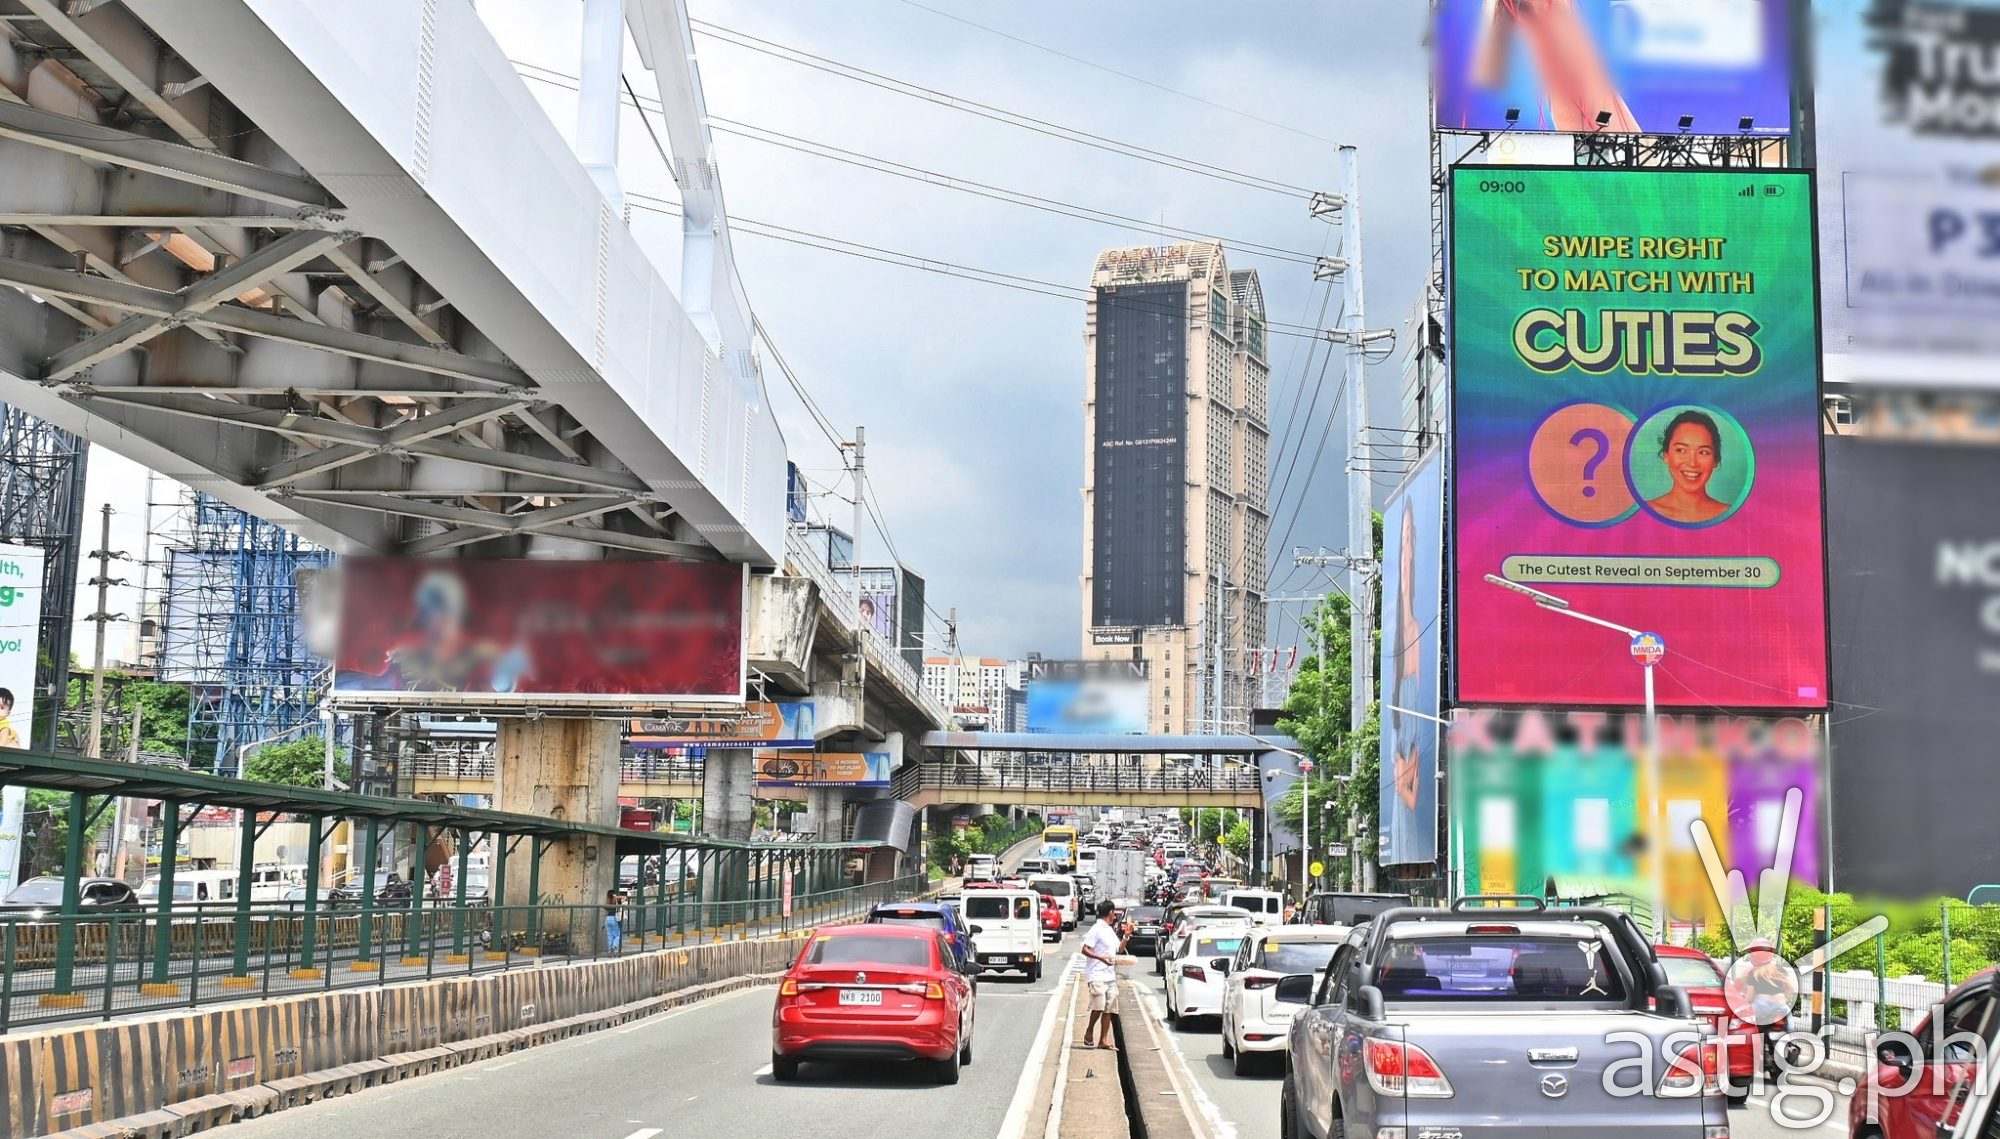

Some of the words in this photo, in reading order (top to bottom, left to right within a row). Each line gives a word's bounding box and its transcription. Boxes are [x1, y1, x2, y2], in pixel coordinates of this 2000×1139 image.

[1480, 180, 1526, 193] 09:00
[1543, 235, 1633, 259] SWIPE
[1638, 237, 1726, 260] RIGHT
[1517, 268, 1558, 292] TO
[1563, 269, 1672, 293] MATCH
[1677, 271, 1754, 294] WITH
[1512, 307, 1763, 377] CUTIES
[1518, 563, 1543, 575] The
[1546, 563, 1592, 576] Cutest
[1595, 563, 1640, 577] Reveal
[1644, 567, 1661, 577] on
[1665, 565, 1740, 581] September
[1744, 566, 1761, 578] 30
[1114, 635, 1130, 643] Now
[1633, 646, 1662, 654] MMDA
[860, 993, 881, 1002] 2100
